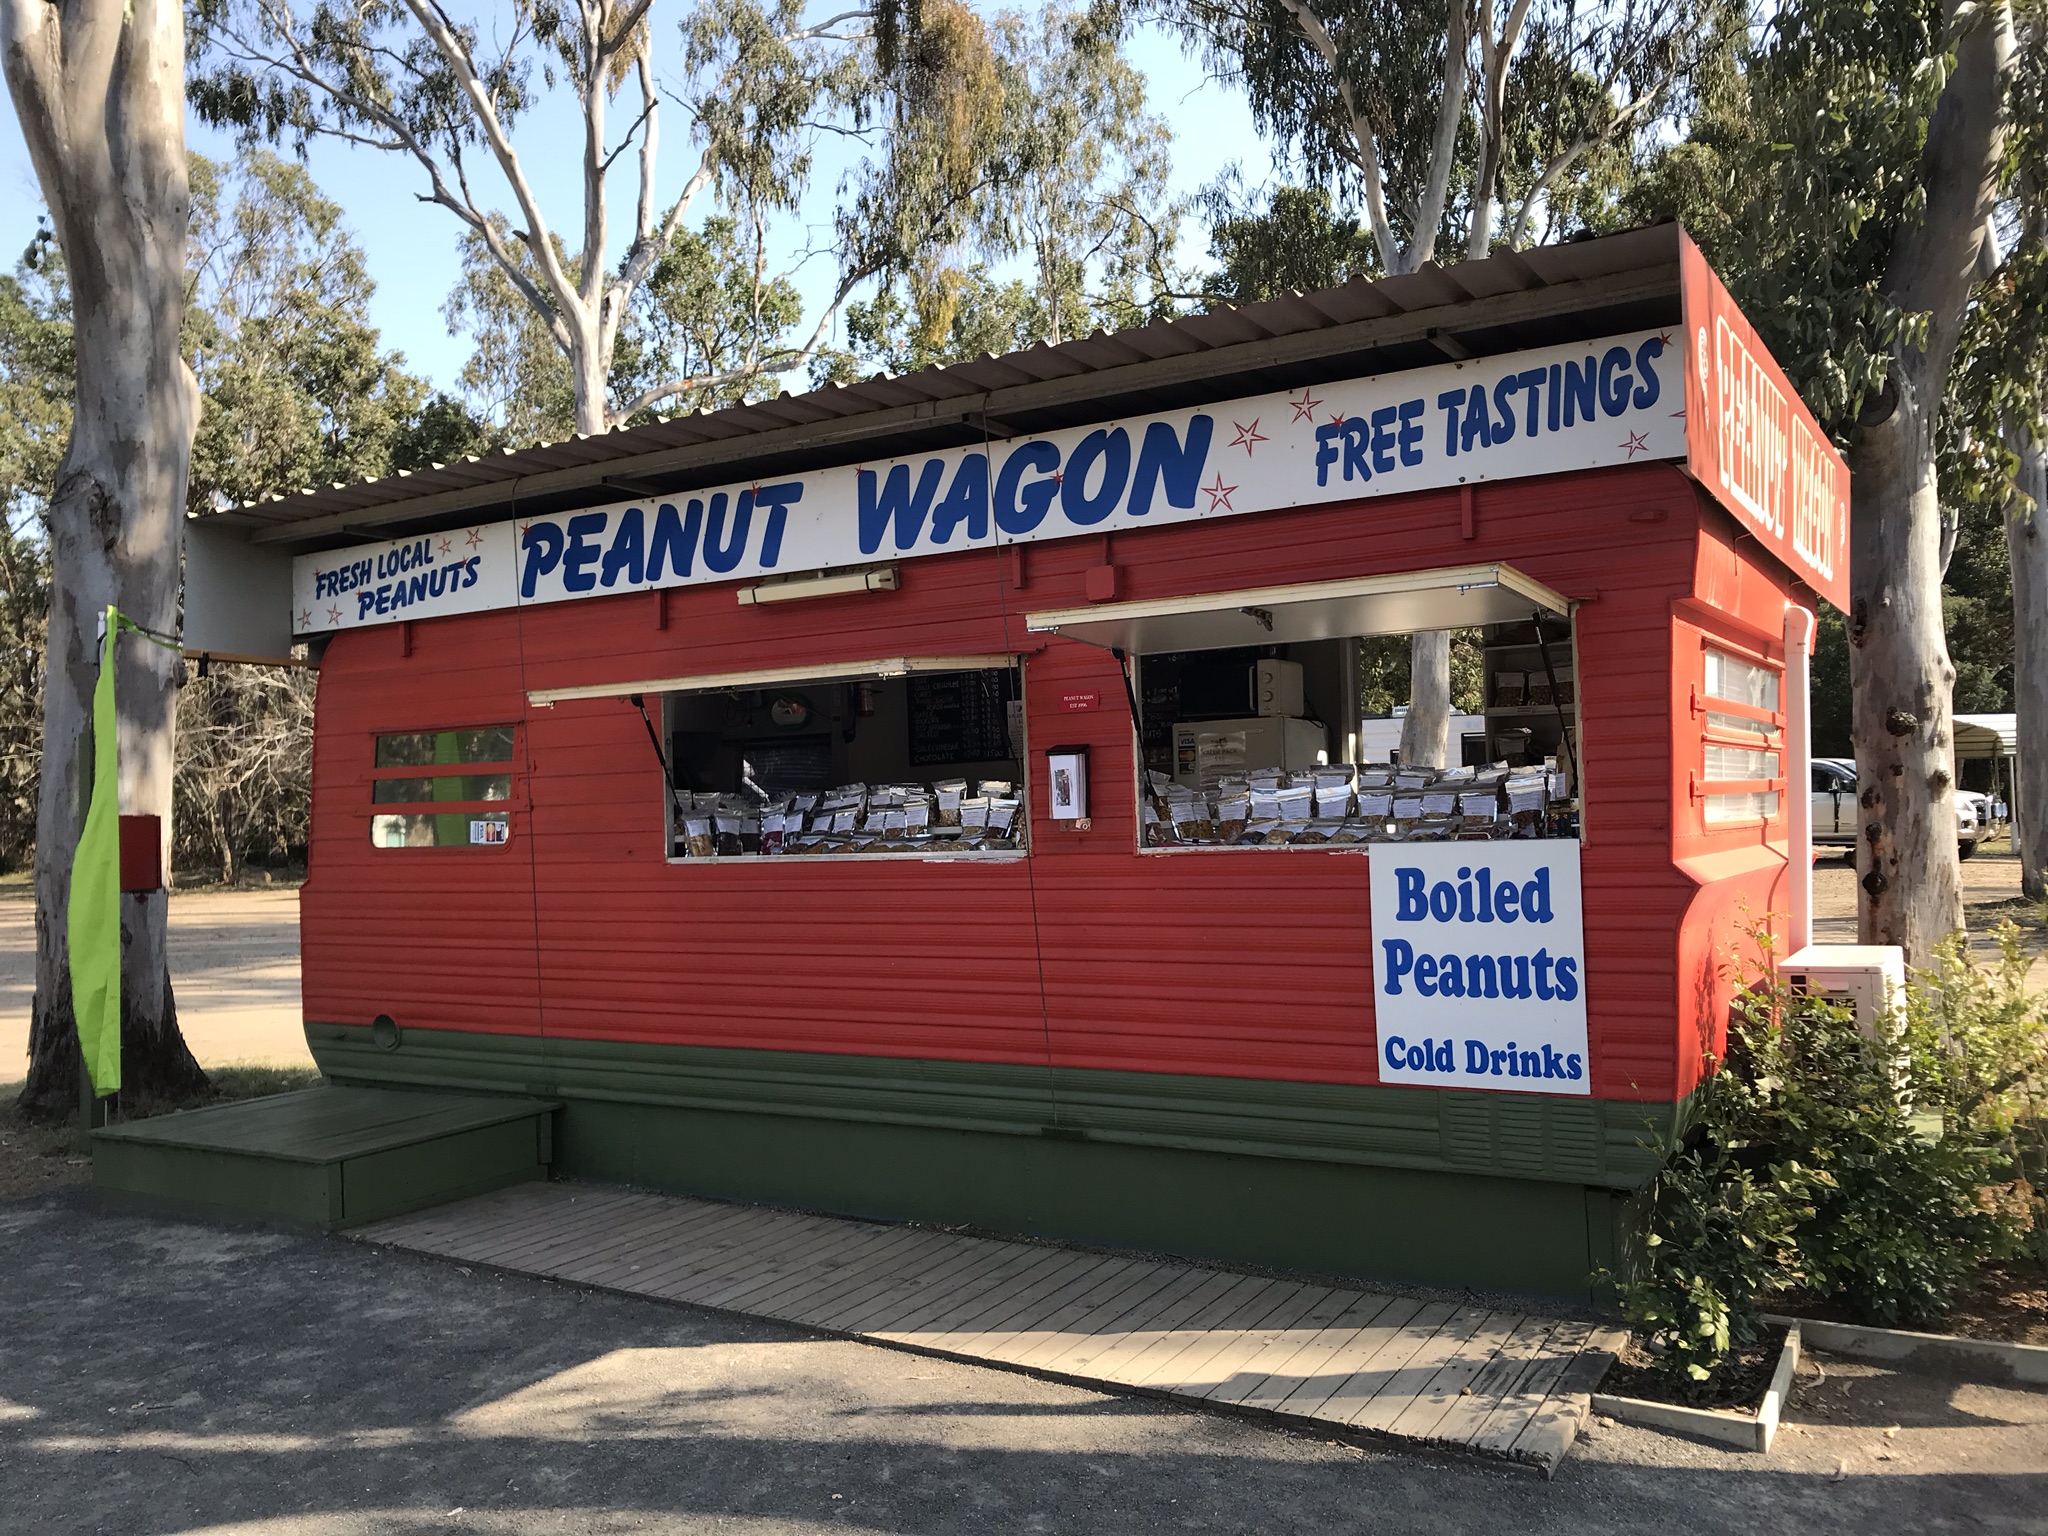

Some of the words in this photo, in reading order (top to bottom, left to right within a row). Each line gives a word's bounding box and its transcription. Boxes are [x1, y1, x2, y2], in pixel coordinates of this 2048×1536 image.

[1315, 399, 1425, 488] FREE
[1437, 337, 1664, 457] TASTINGS
[520, 482, 804, 598] PEANUT
[857, 414, 1214, 555] WAGON
[314, 558, 373, 601] FRESH
[376, 538, 434, 581] LOCAL
[357, 556, 481, 621] PEANUTS
[1394, 866, 1554, 924] Boiled
[1381, 938, 1578, 1001] Peanuts
[1384, 1035, 1456, 1073] Cold
[1464, 1039, 1583, 1080] Drinks
